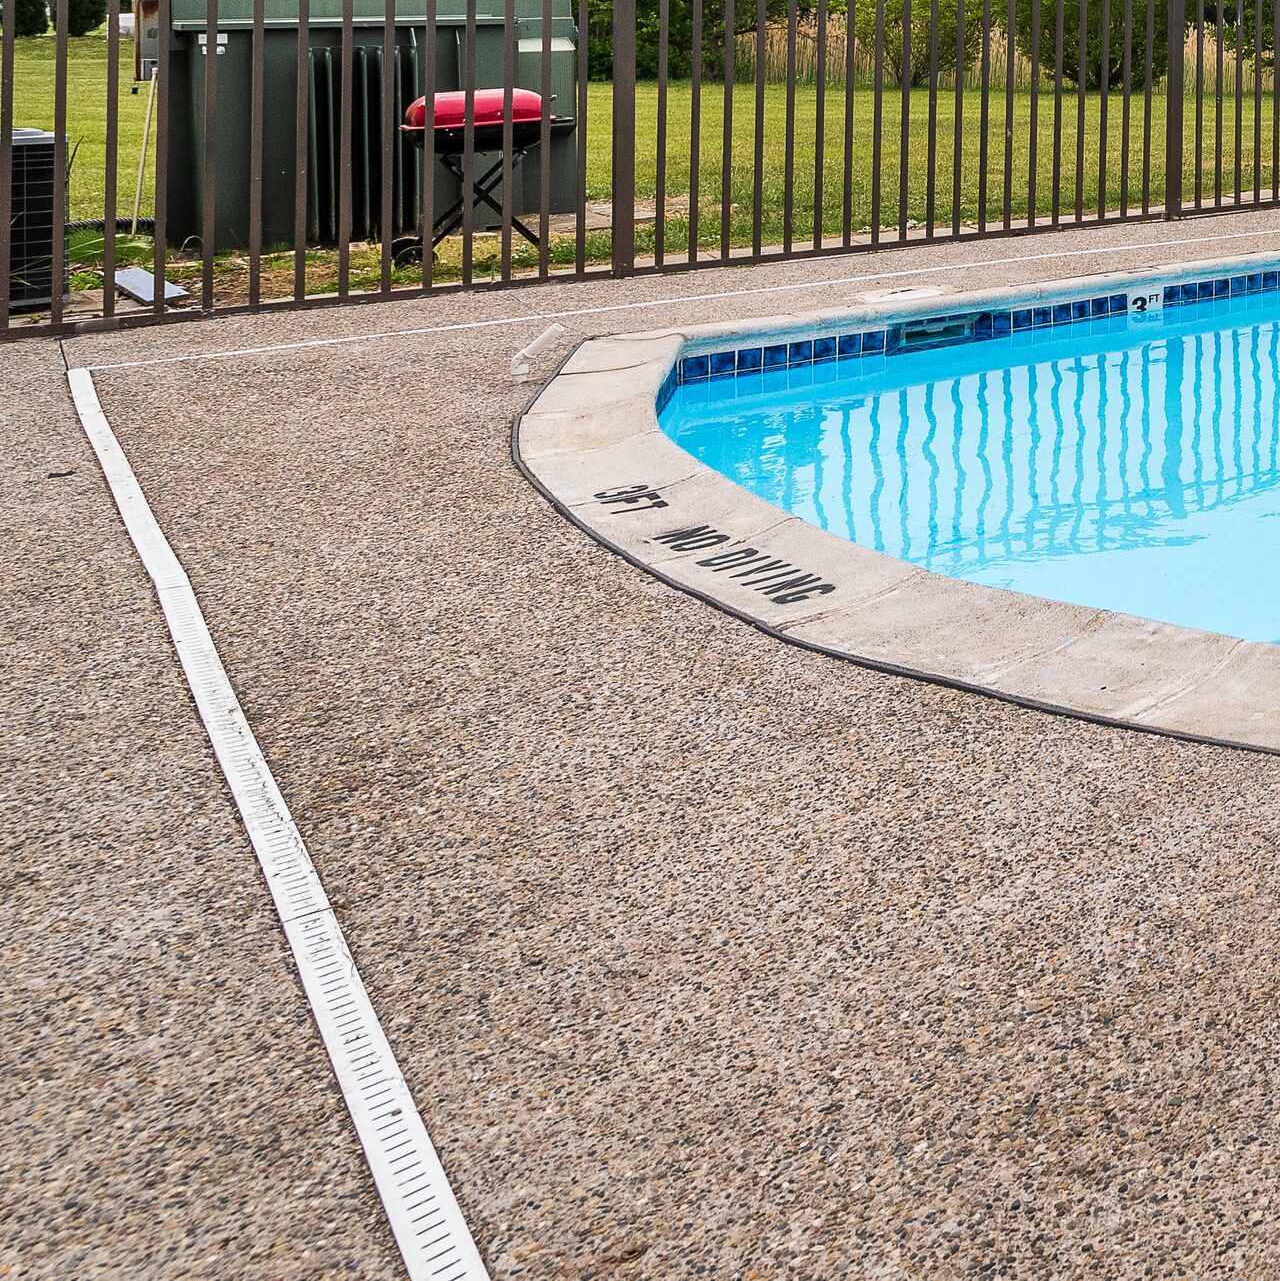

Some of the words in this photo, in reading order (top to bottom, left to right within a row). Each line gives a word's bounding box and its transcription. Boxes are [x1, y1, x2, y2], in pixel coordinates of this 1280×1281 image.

[593, 484, 669, 514] 3FT
[651, 525, 731, 552] NO
[695, 548, 836, 604] DIVING
